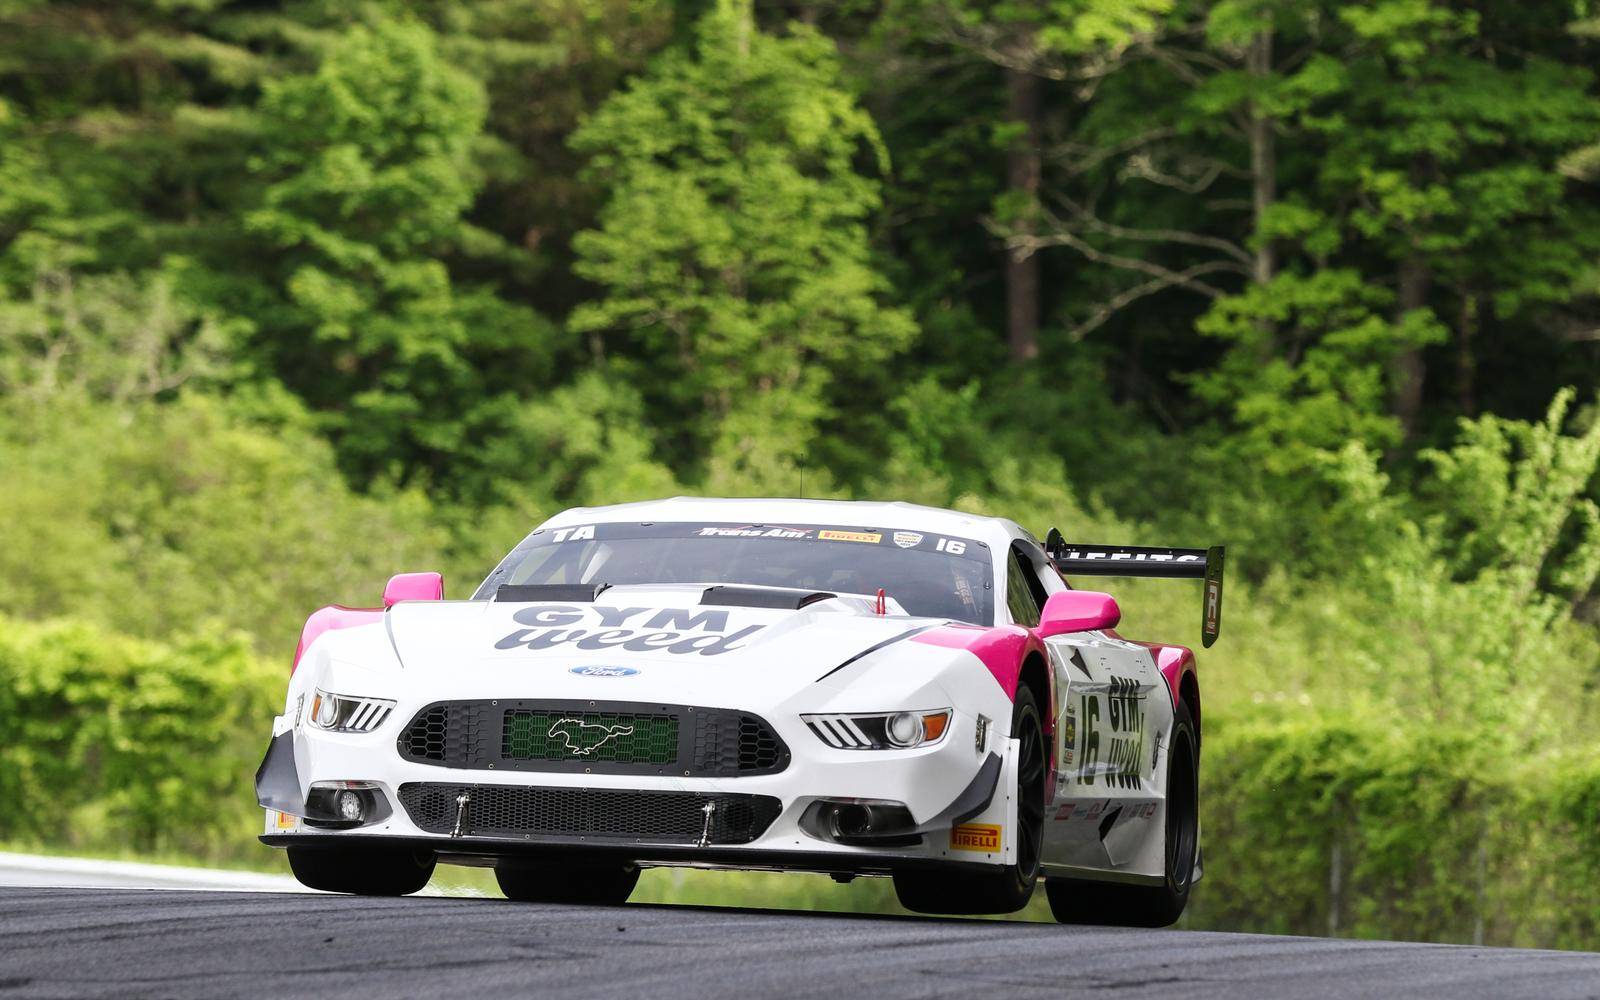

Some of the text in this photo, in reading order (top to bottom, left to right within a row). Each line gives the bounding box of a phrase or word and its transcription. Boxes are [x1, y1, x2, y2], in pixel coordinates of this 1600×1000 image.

[552, 525, 595, 543] TA
[698, 527, 764, 537] Trans
[935, 537, 967, 555] 16
[512, 605, 730, 632] GYM
[494, 624, 767, 657] weed
[581, 665, 625, 677] Ford
[1107, 674, 1142, 734] GYM
[1077, 694, 1100, 786] 16
[951, 826, 999, 848] PIRELLI
